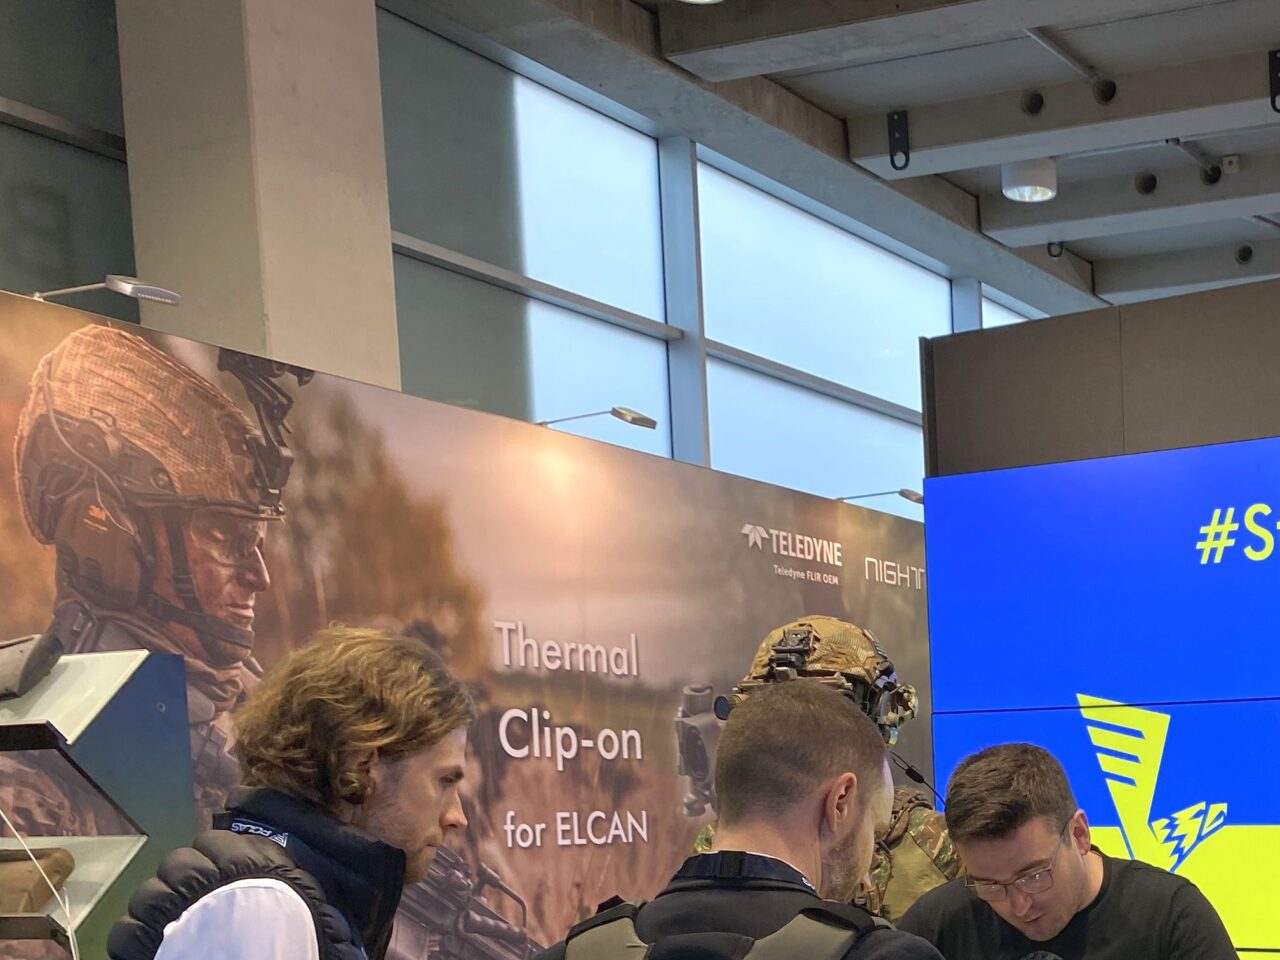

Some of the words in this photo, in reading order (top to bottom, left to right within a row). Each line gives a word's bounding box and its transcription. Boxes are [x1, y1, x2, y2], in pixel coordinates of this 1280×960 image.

[769, 528, 843, 566] TELEDYNE
[773, 564, 805, 581] Teledyne
[806, 570, 821, 583] FLIR
[823, 573, 839, 586] OEM
[494, 620, 639, 676] Thermal
[499, 707, 643, 771] Clip-on
[504, 810, 545, 849] for
[557, 809, 648, 846] ELCAN
